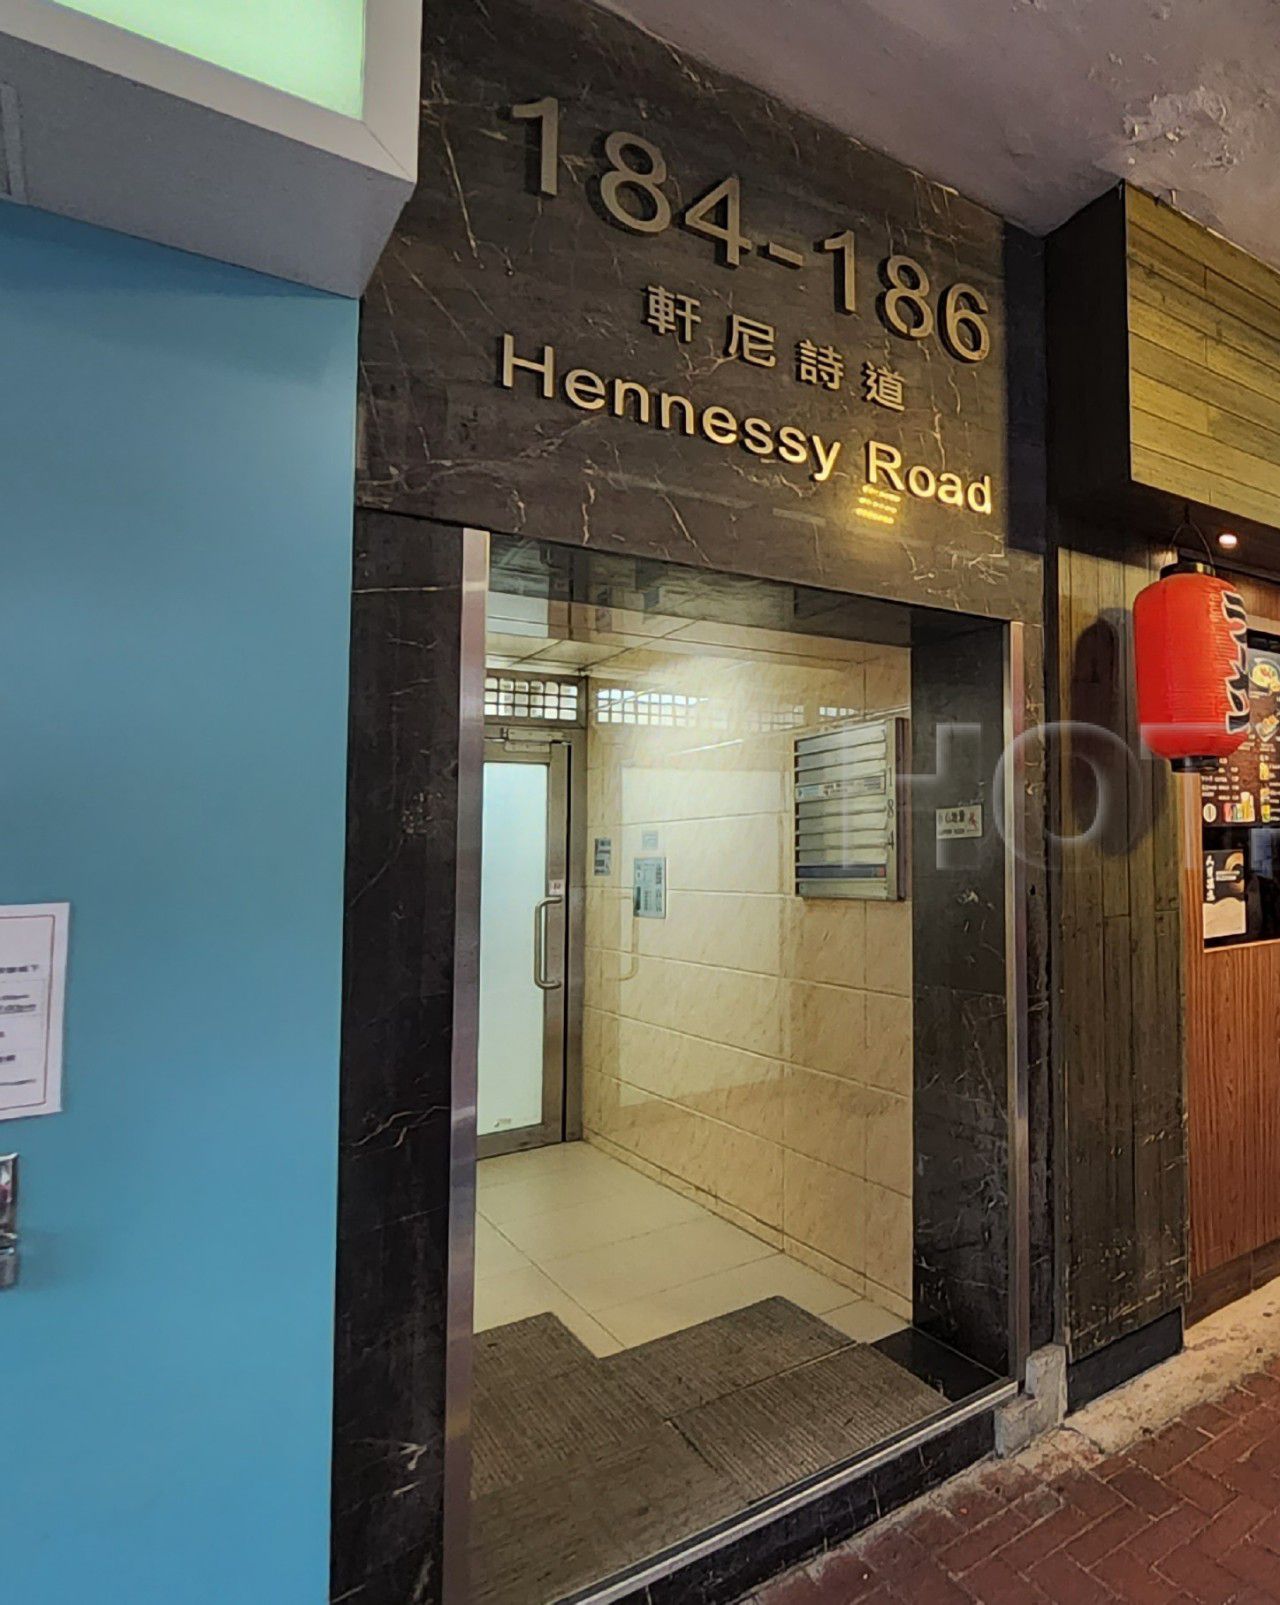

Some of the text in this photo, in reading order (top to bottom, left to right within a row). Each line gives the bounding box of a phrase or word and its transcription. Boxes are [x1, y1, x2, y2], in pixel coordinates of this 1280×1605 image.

[511, 96, 990, 362] 184-186
[501, 334, 993, 514] Hennessy Road
[645, 284, 907, 411] 軒尼詩道
